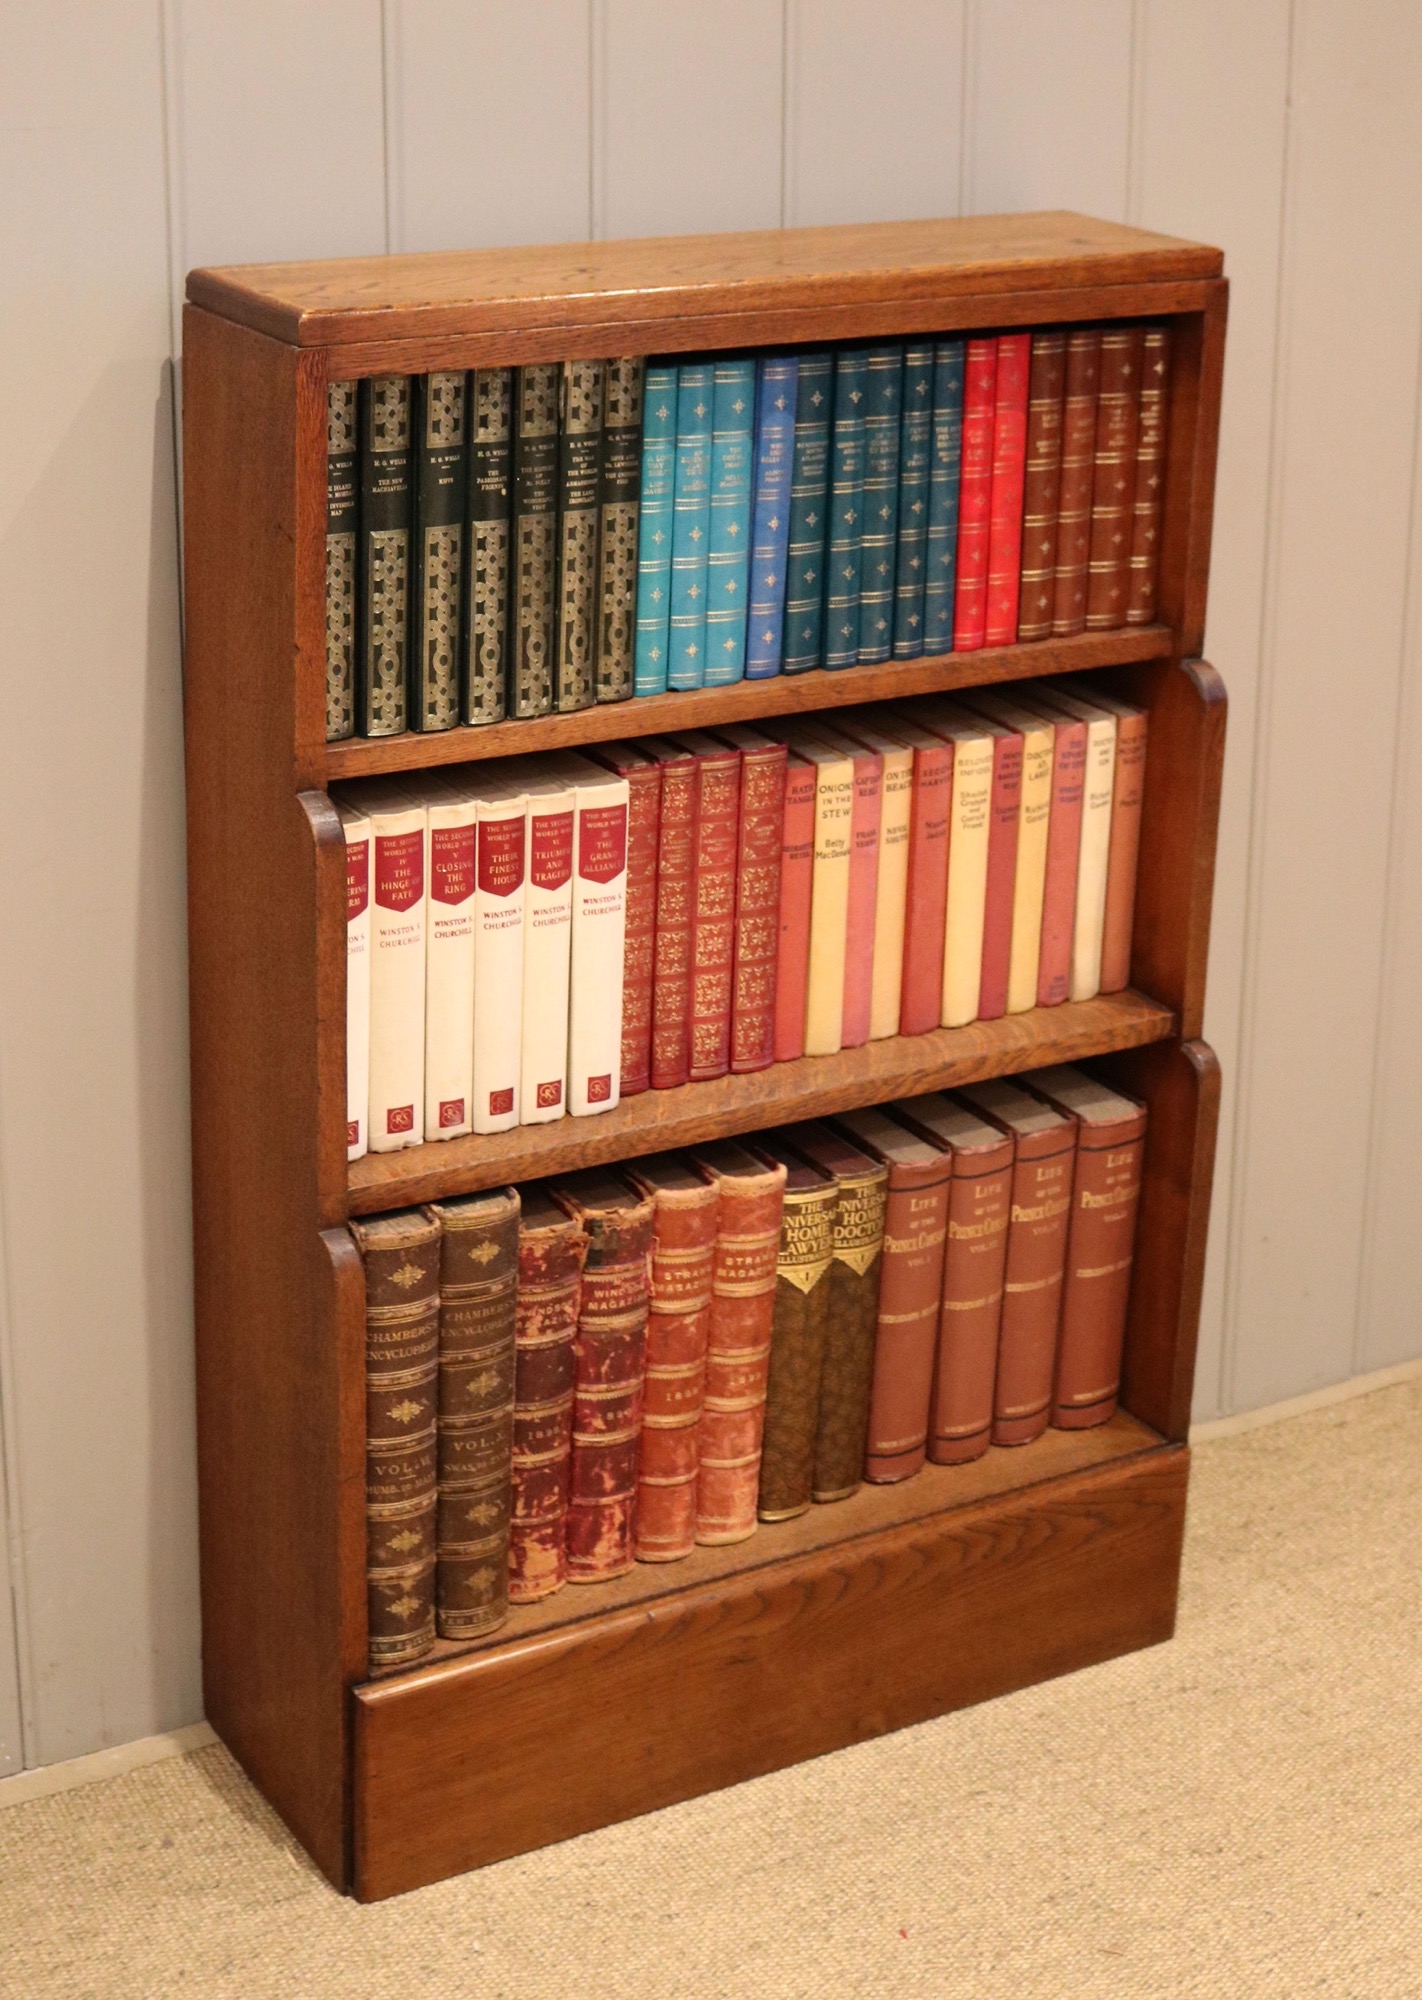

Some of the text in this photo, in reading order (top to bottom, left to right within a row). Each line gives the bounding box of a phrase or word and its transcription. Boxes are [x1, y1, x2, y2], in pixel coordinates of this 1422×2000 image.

[885, 771, 899, 781] ON
[835, 795, 851, 804] THE
[821, 808, 852, 819] STEW
[487, 825, 500, 833] THE
[535, 821, 549, 829] THE
[586, 820, 609, 829] WORLD
[434, 834, 449, 842] THE
[487, 833, 510, 842] WORLD
[535, 829, 559, 838] WORLD
[434, 842, 460, 850] WORLD
[595, 840, 613, 850] THE
[824, 839, 845, 850] Betty
[382, 848, 407, 857] WORLD
[491, 852, 519, 864] THEIR
[534, 847, 571, 861] TRIUMPH
[589, 849, 619, 863] GRAND
[435, 860, 474, 873] CLOSING
[489, 863, 520, 875] FINEST
[545, 859, 564, 871] AND
[583, 858, 623, 873] ALLIANCE
[394, 868, 412, 878] THE
[446, 872, 464, 883] THE
[534, 868, 570, 882] TRAGEDY
[381, 880, 410, 891] HINGE
[493, 874, 518, 886] HOUR
[444, 882, 467, 895] RING
[391, 889, 414, 901] FATE
[582, 896, 617, 905] WINSTON
[483, 908, 518, 920] WINSTON
[532, 904, 566, 916] WINSTON
[582, 904, 622, 917] CHURCHILL
[434, 917, 467, 928] WINSTON
[483, 918, 523, 931] CHURCHILL
[532, 913, 571, 928] CHURCHILL
[379, 924, 416, 937] WINSTON
[434, 926, 473, 939] CHURCHILL
[379, 934, 422, 949] CHURCHILL
[857, 1185, 878, 1198] THE
[801, 1201, 824, 1214] THE
[843, 1207, 883, 1226] HOME
[786, 1222, 831, 1242] HOME
[834, 1221, 884, 1240] DOCTOR
[454, 1438, 495, 1451] VOL.
